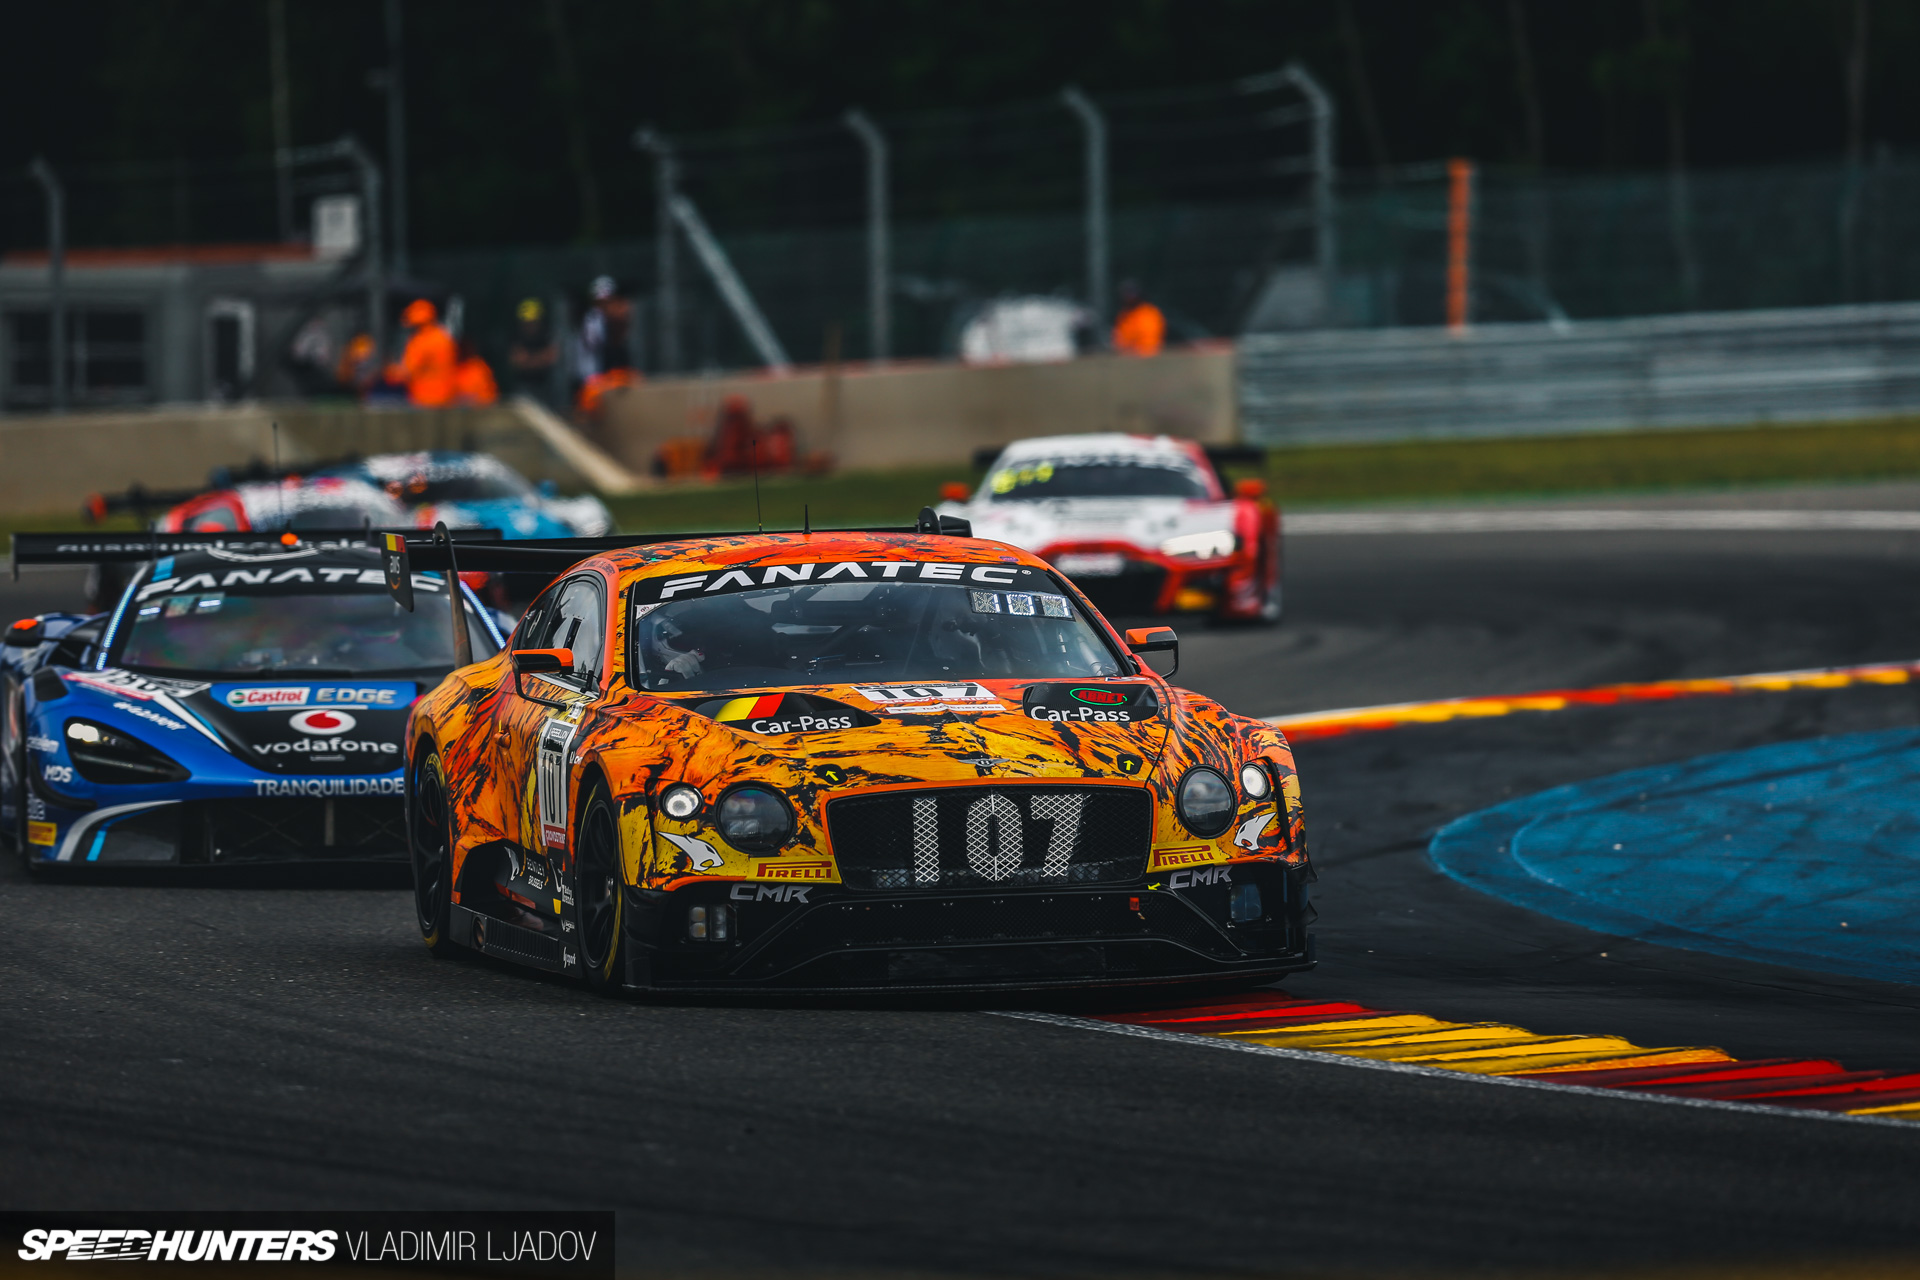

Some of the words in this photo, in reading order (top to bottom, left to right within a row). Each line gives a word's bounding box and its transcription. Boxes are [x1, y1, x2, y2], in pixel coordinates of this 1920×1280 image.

[134, 567, 446, 602] FANATEC
[247, 689, 303, 704] Castrol
[315, 687, 397, 704] EDGE
[1030, 705, 1131, 721] Car-Pass
[751, 715, 852, 734] Car-Pass
[252, 737, 399, 755] vodafone
[252, 776, 405, 798] TRANQUILIDADE
[912, 793, 1089, 882] 107
[1153, 845, 1214, 867] PIRELLI
[756, 861, 833, 879] PIRELLI
[1169, 865, 1233, 890] CMR
[729, 883, 814, 904] CMR
